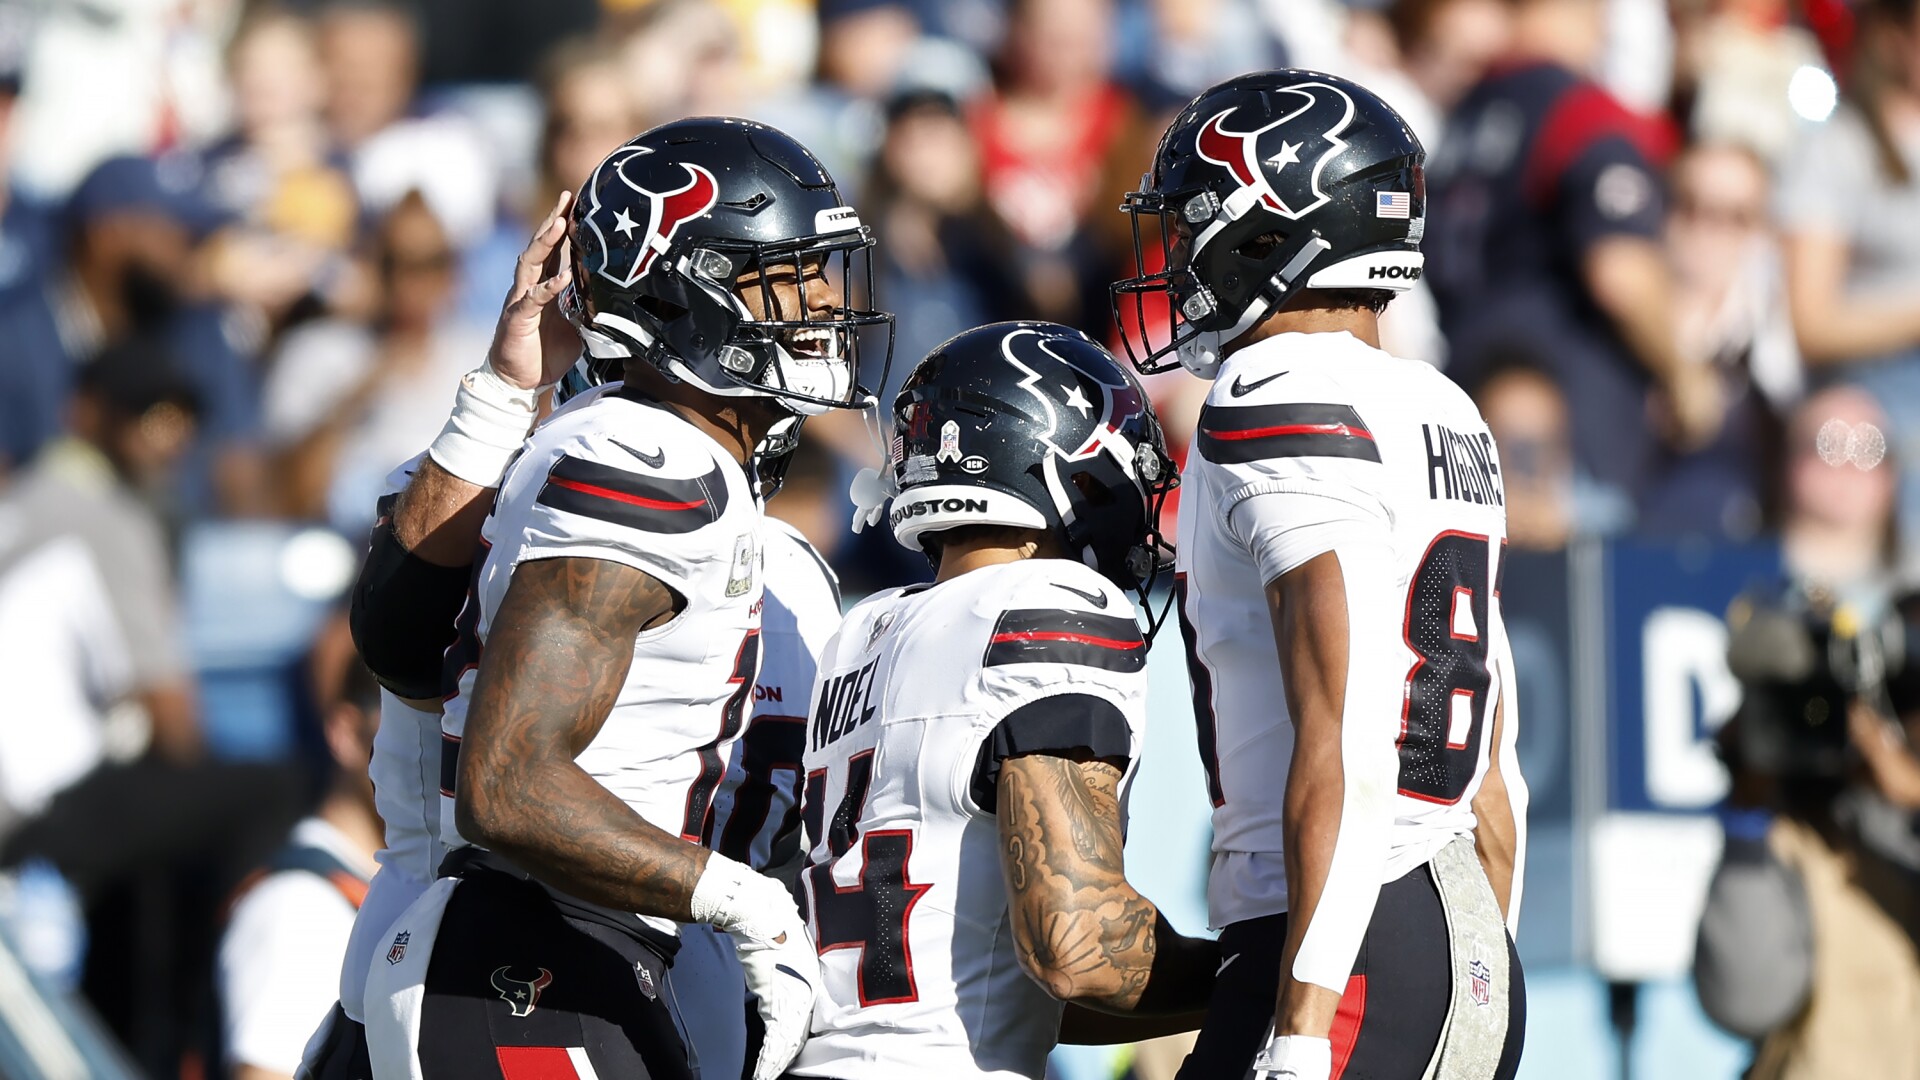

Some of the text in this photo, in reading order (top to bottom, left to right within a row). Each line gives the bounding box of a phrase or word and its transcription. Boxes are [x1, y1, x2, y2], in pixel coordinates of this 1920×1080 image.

[889, 498, 988, 532] HOUSTON
[812, 653, 882, 753] NOEL
[1397, 528, 1509, 807] 8
[795, 747, 935, 1008] 14
[1471, 976, 1489, 1002] NFL
